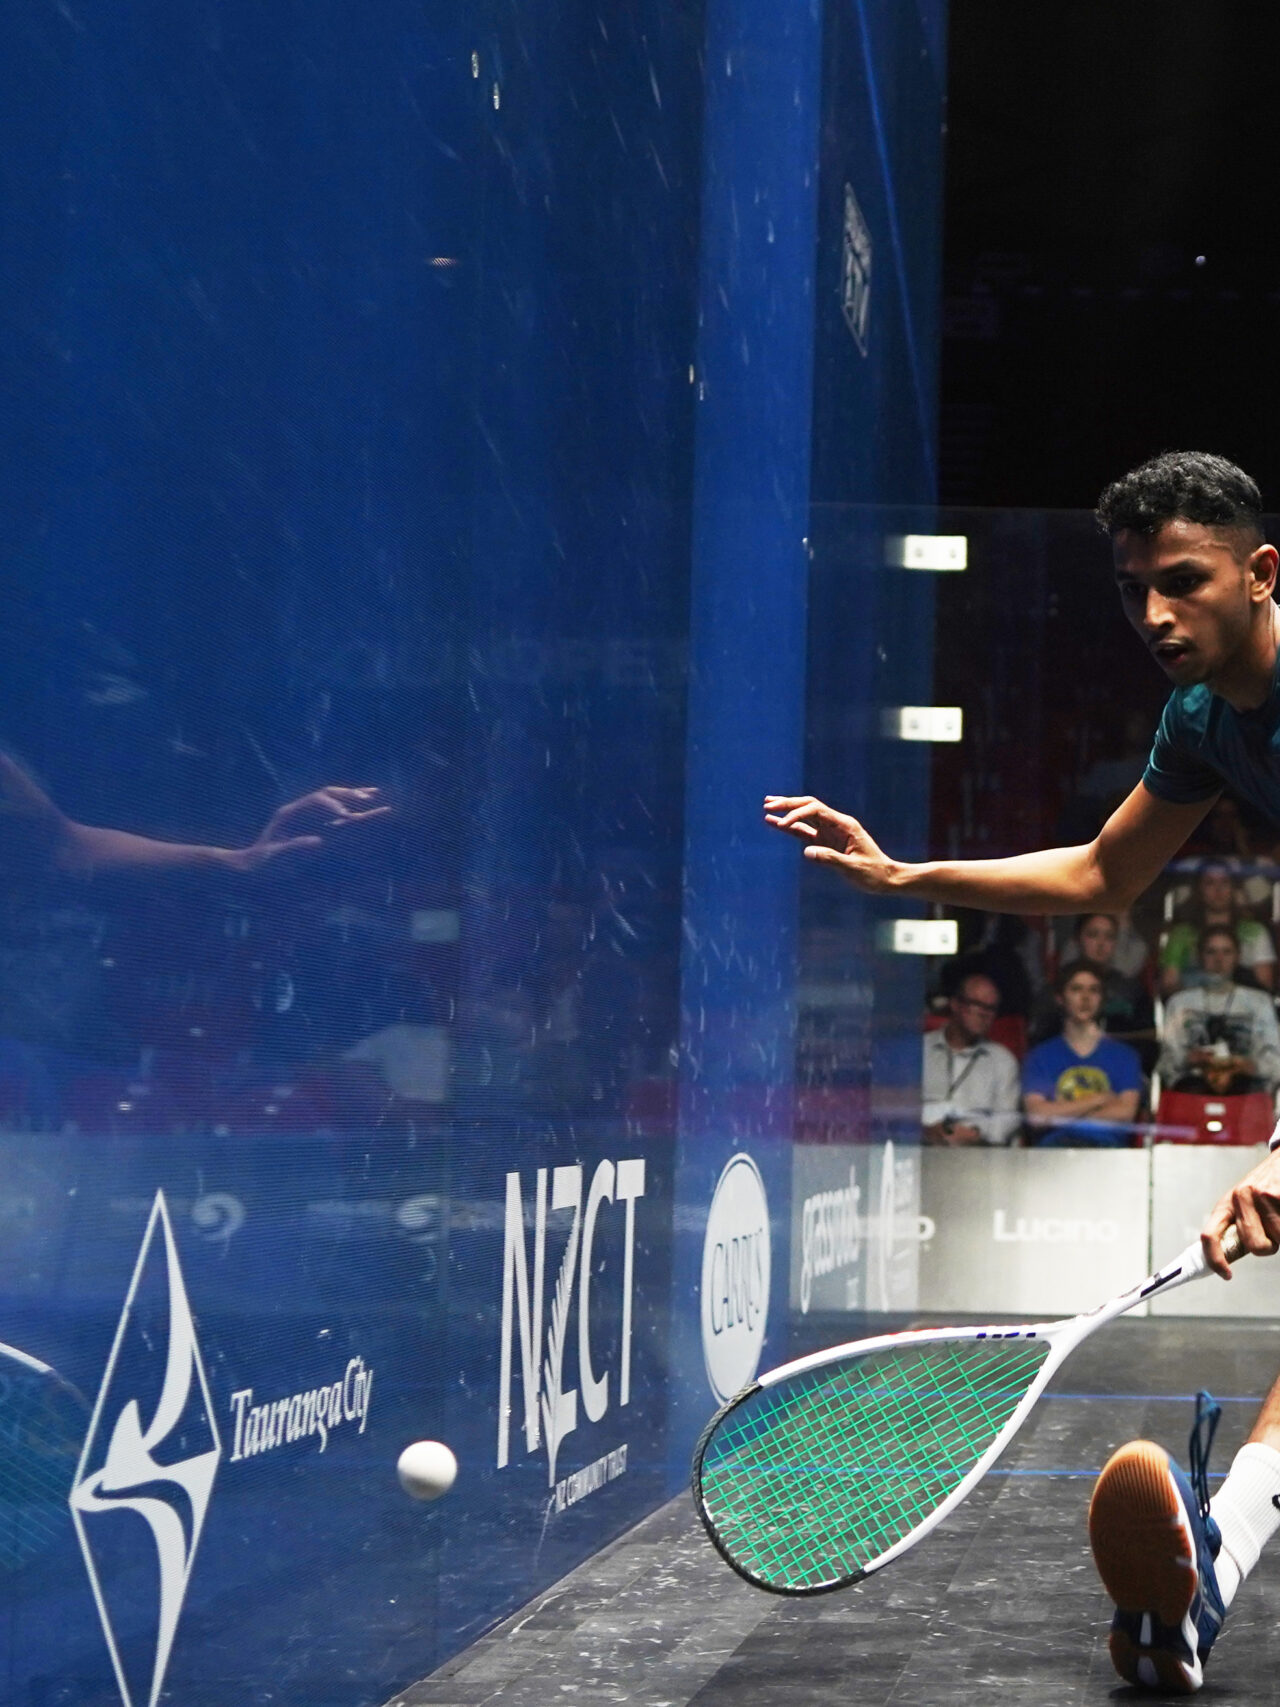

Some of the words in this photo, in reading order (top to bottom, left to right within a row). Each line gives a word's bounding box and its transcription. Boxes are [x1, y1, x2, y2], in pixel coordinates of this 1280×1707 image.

[230, 1388, 344, 1463] Tauranga
[343, 1355, 374, 1434] City
[498, 1158, 645, 1469] NZCT
